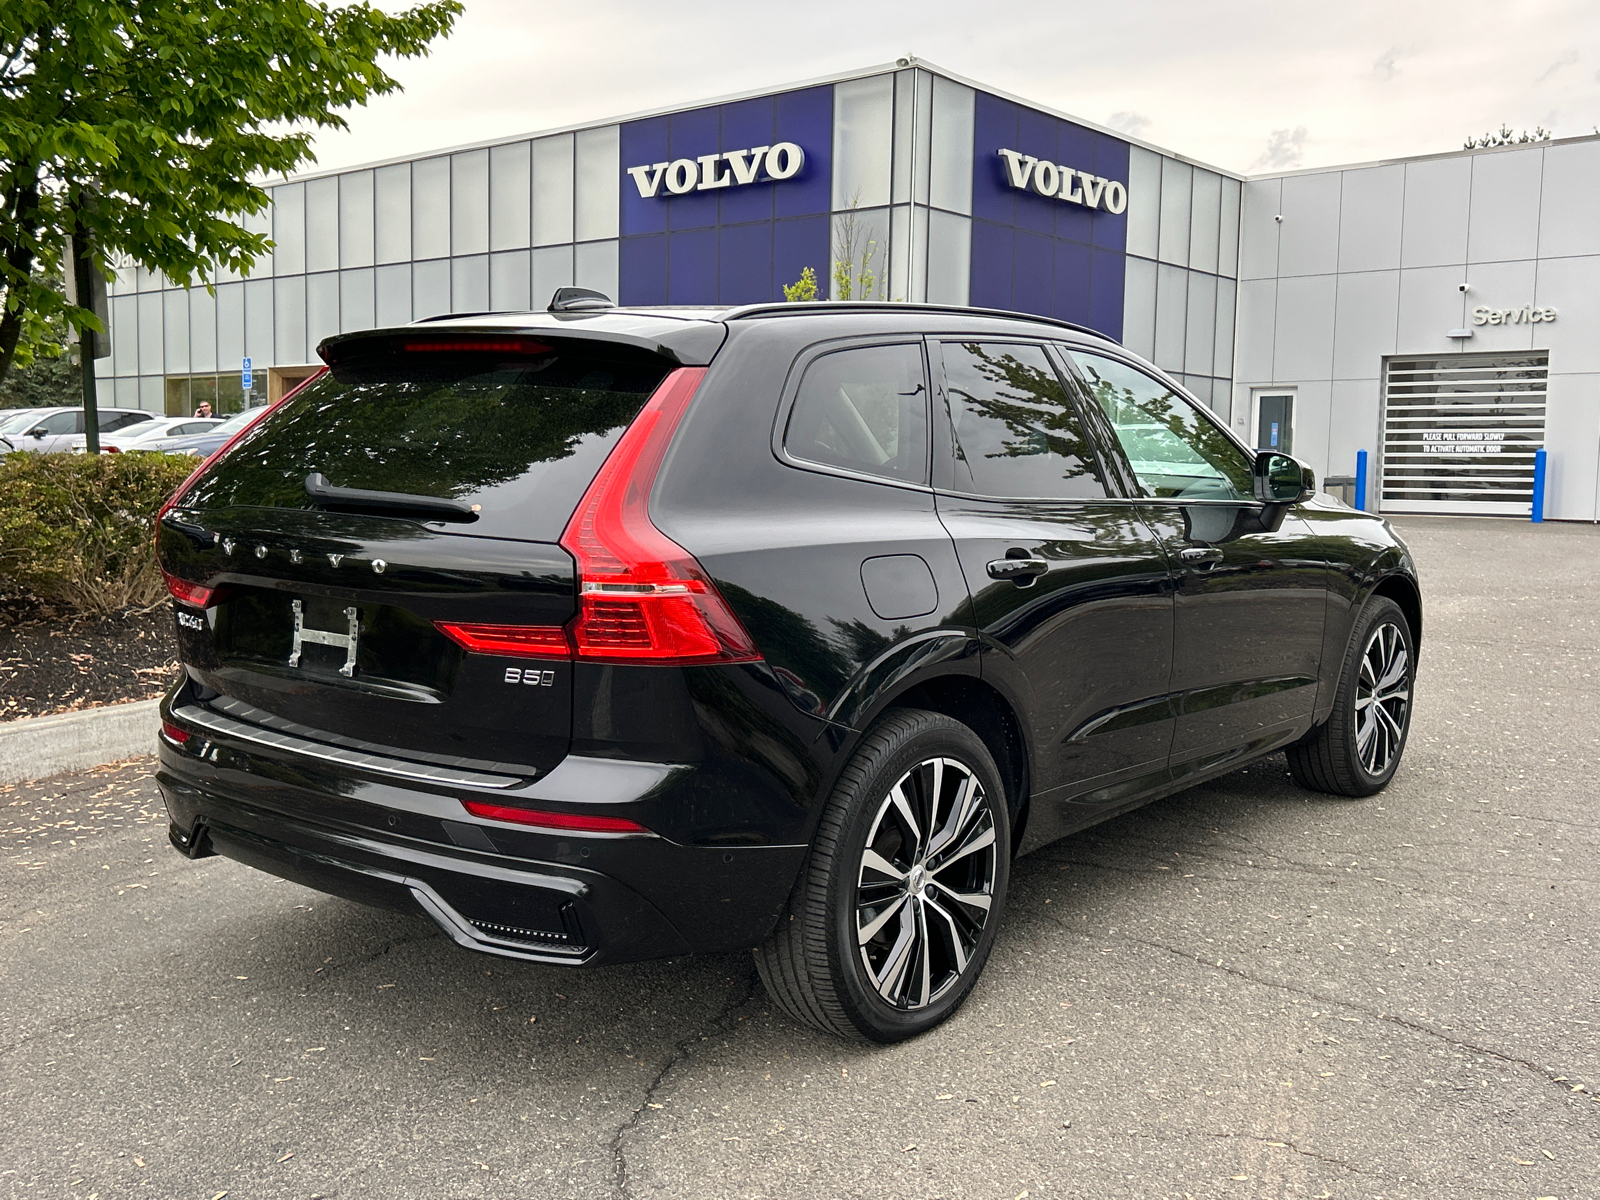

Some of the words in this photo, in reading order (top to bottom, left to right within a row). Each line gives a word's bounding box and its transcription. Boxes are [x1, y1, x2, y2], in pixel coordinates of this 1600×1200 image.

[627, 141, 805, 198] VOLVO
[998, 148, 1127, 215] VOLVO
[1472, 304, 1556, 326] Service
[1422, 432, 1442, 441] PLEASE
[1443, 432, 1456, 441] PULL
[1456, 432, 1483, 441] FORWARD
[1483, 432, 1505, 441] SLOWLY
[1423, 444, 1430, 453] TO
[1430, 444, 1455, 453] ACTIVATE
[1455, 444, 1485, 453] AUTOMATIC
[1485, 444, 1502, 453] DOOR
[221, 541, 389, 574] VOLVO
